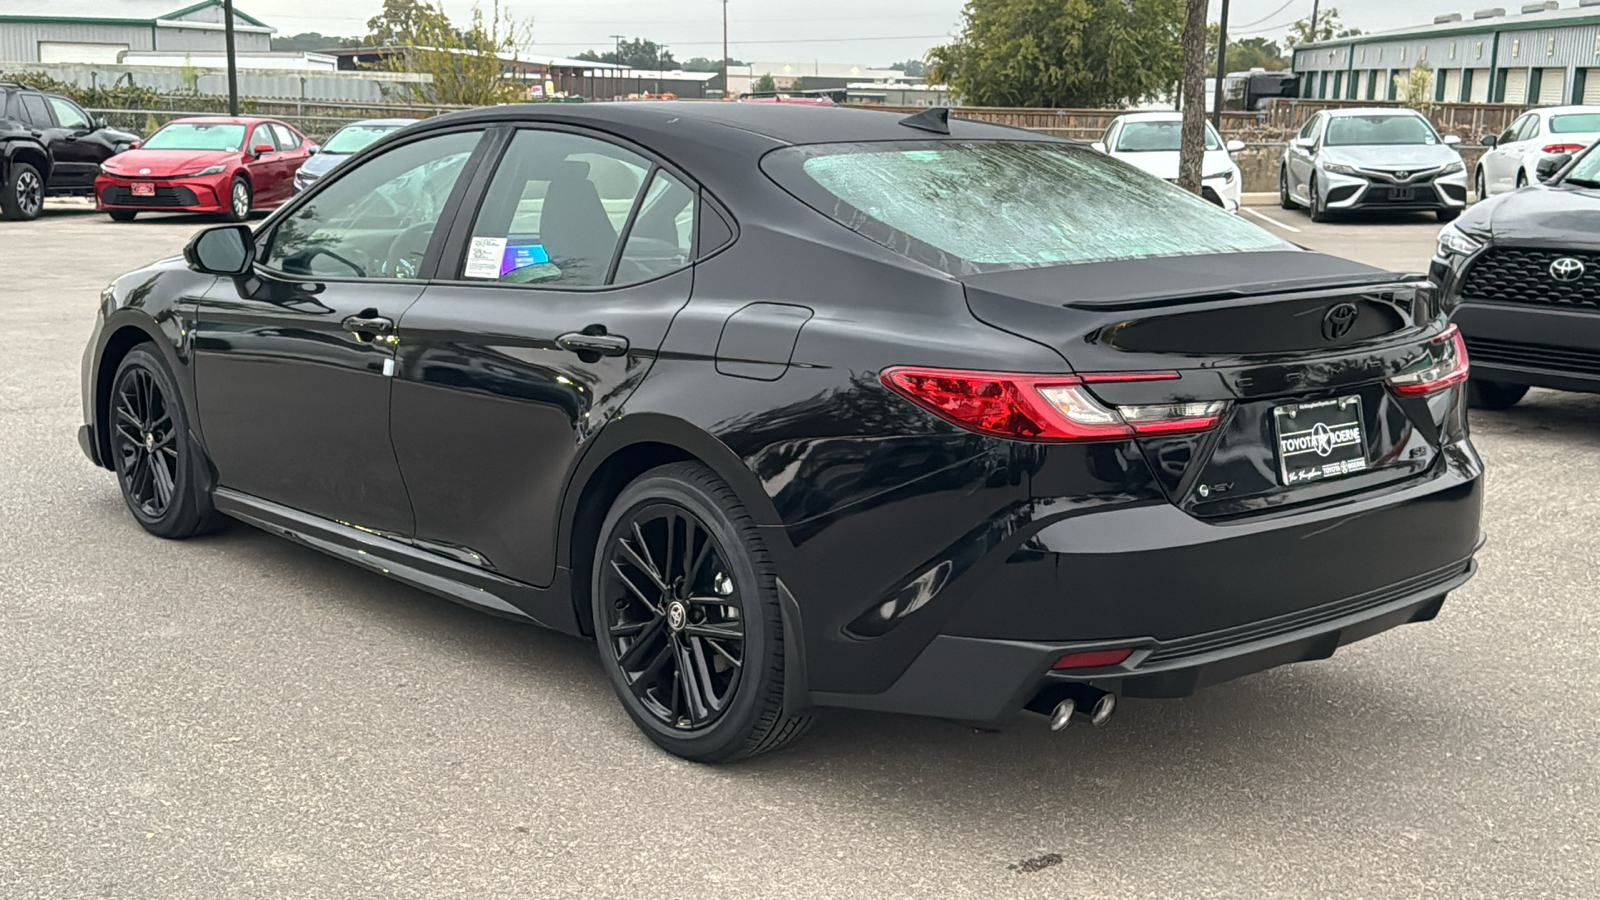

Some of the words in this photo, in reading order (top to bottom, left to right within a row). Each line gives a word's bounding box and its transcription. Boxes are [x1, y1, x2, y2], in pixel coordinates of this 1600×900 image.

[1281, 435, 1318, 452] TOYOTA
[1330, 427, 1360, 444] BOERNE
[1209, 482, 1235, 494] HEV
